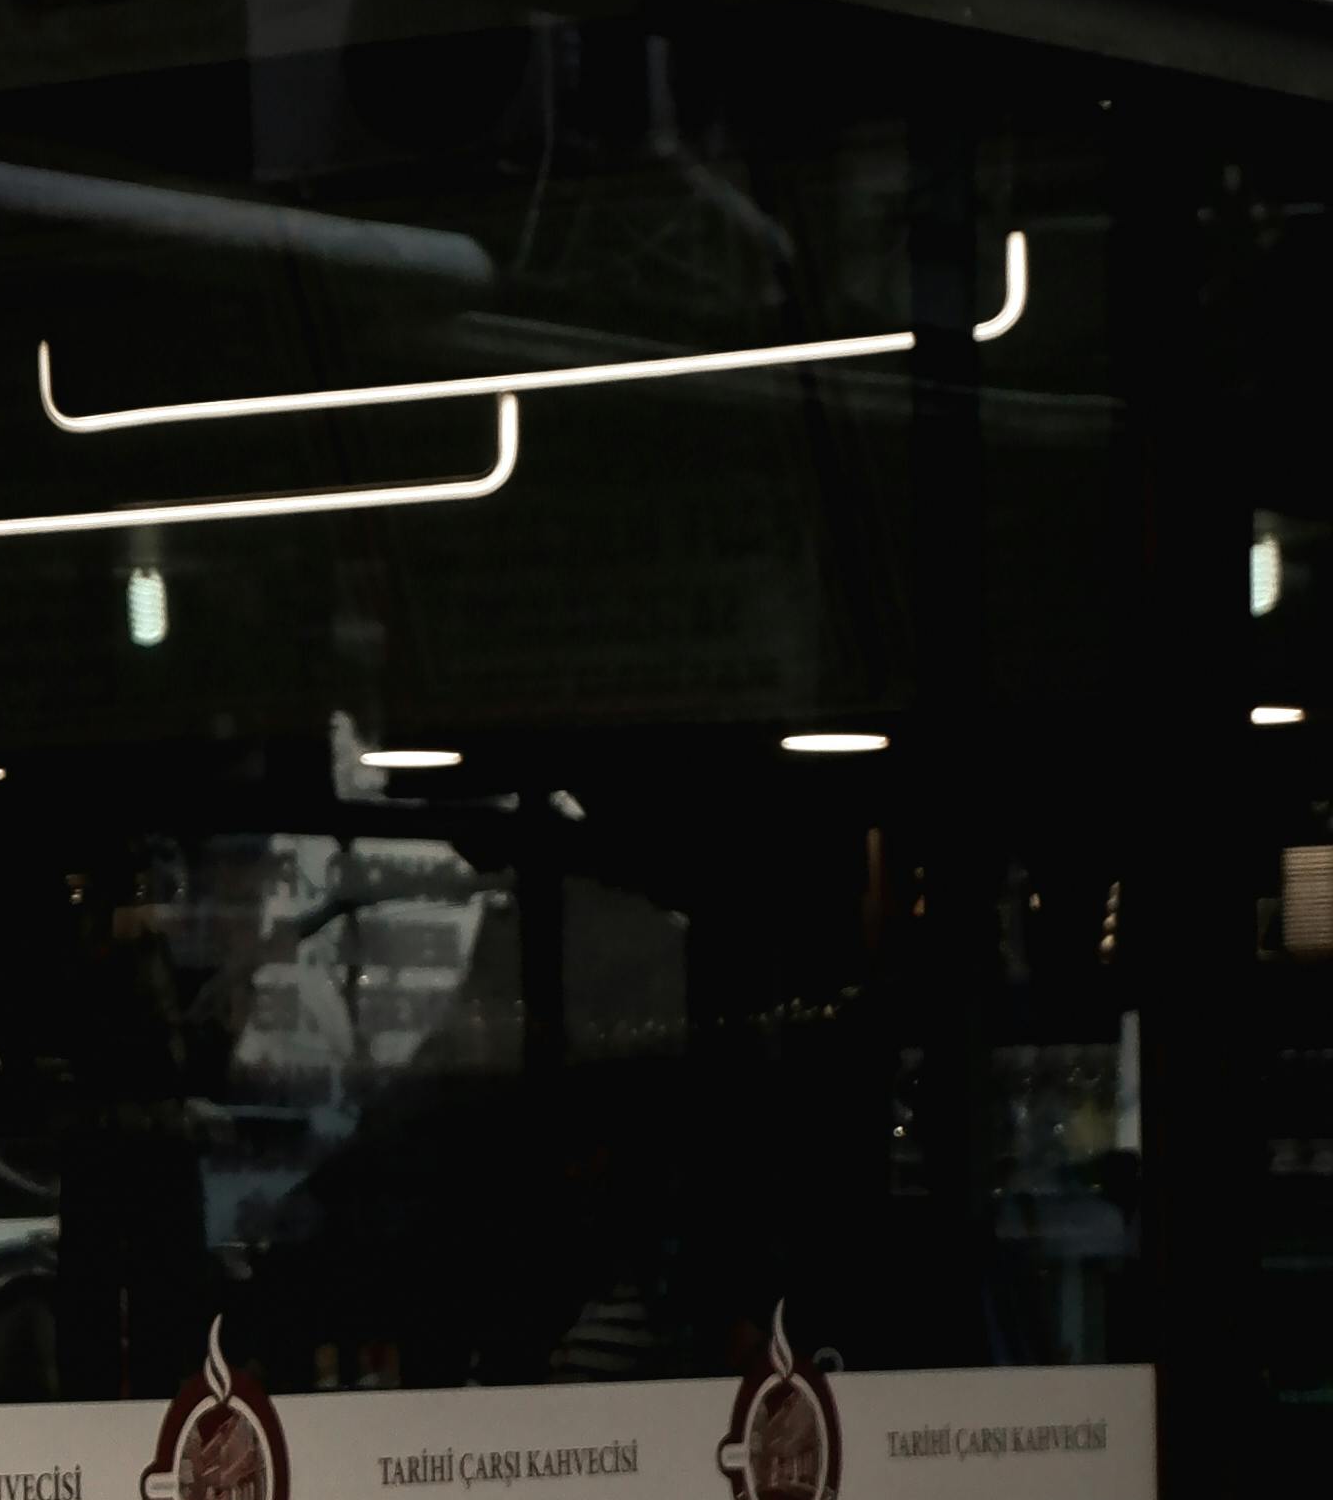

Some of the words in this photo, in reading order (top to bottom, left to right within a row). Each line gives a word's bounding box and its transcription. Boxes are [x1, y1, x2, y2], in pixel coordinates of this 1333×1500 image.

[378, 1447, 454, 1487] TARİHİ
[459, 1451, 522, 1490] ÇARŞI
[526, 1438, 639, 1481] KAHVECİSİ
